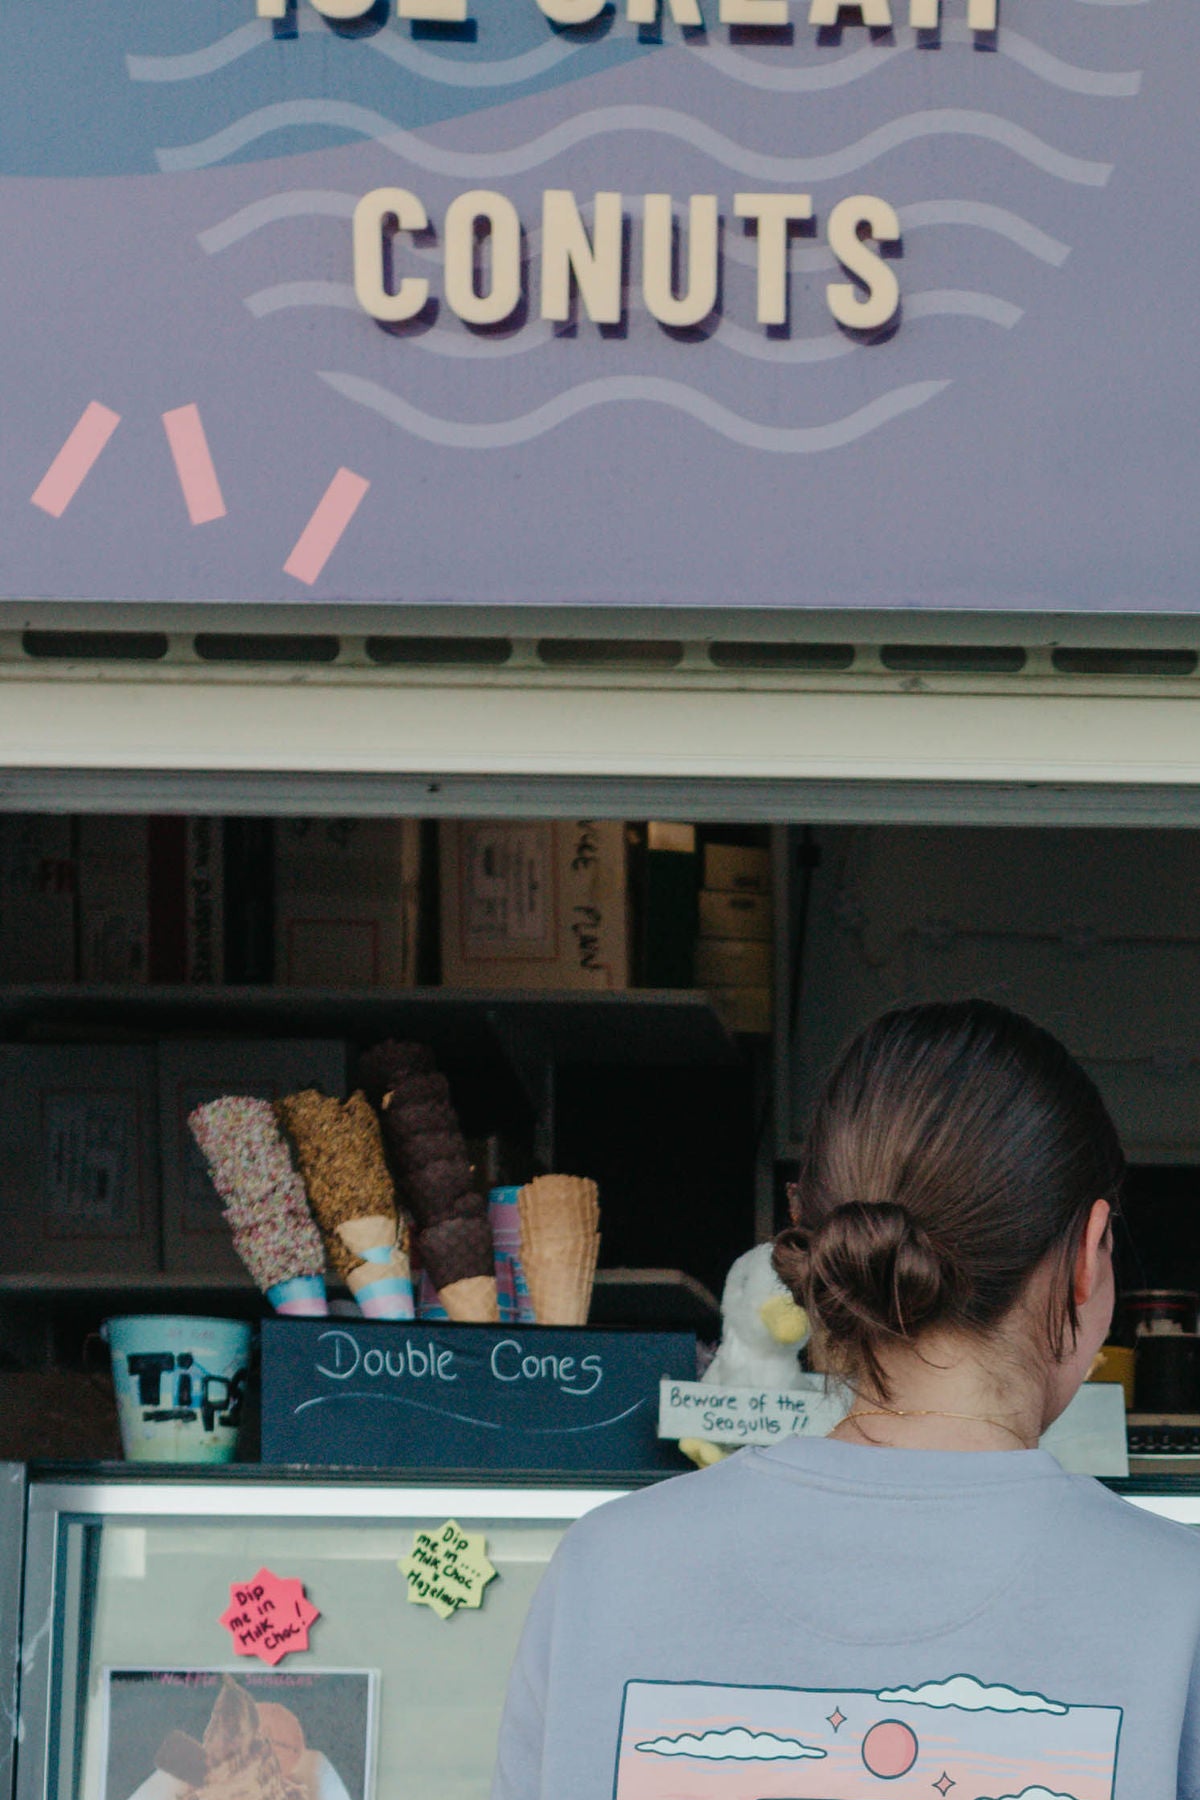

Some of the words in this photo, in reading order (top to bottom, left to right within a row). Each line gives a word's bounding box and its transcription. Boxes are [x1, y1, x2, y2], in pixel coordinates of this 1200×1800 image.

[351, 187, 903, 330] CONUTS
[316, 1331, 457, 1379] Double
[491, 1340, 602, 1395] Cones
[127, 1353, 248, 1431] Tips
[671, 1387, 737, 1411] Beware
[750, 1393, 767, 1413] of
[777, 1394, 806, 1413] the
[703, 1412, 781, 1436] Seagulls
[417, 1533, 439, 1552] me
[442, 1526, 469, 1551] Dip
[235, 1584, 264, 1606] Dip
[229, 1613, 252, 1632] me
[258, 1600, 275, 1616] in
